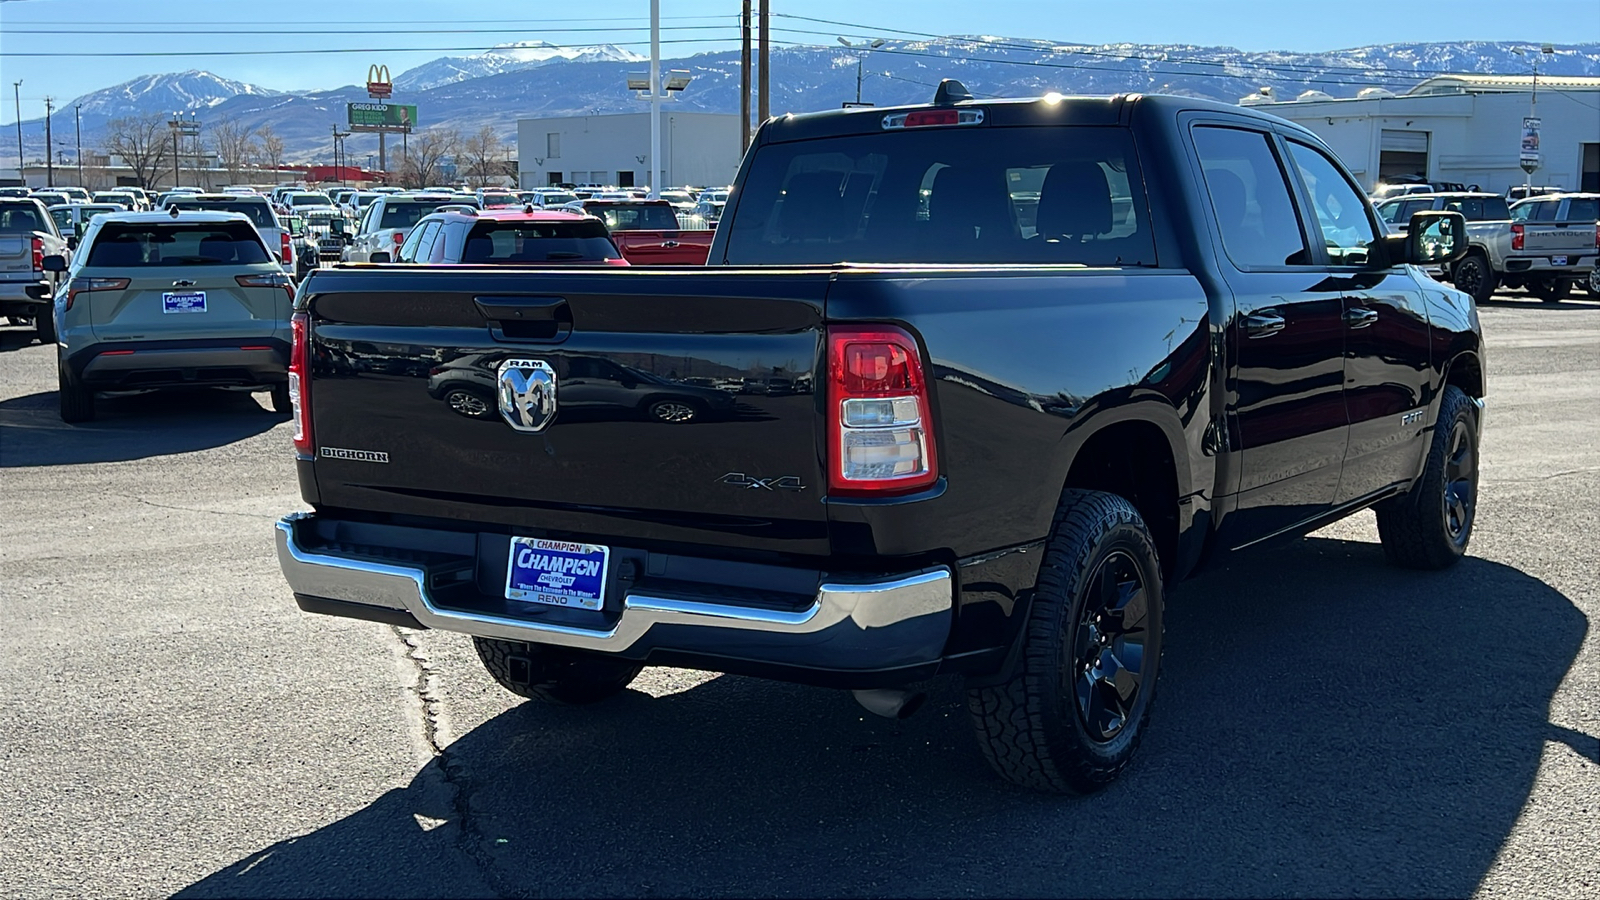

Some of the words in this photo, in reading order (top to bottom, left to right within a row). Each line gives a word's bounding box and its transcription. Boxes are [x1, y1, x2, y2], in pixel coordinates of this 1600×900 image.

[352, 103, 371, 111] GREG
[372, 104, 388, 112] KIDD
[321, 447, 389, 463] BIGHORN
[536, 540, 583, 553] CHAMPION
[517, 548, 601, 577] CHAMPION
[540, 574, 574, 585] CHEVROLET
[537, 594, 568, 605] RENO
